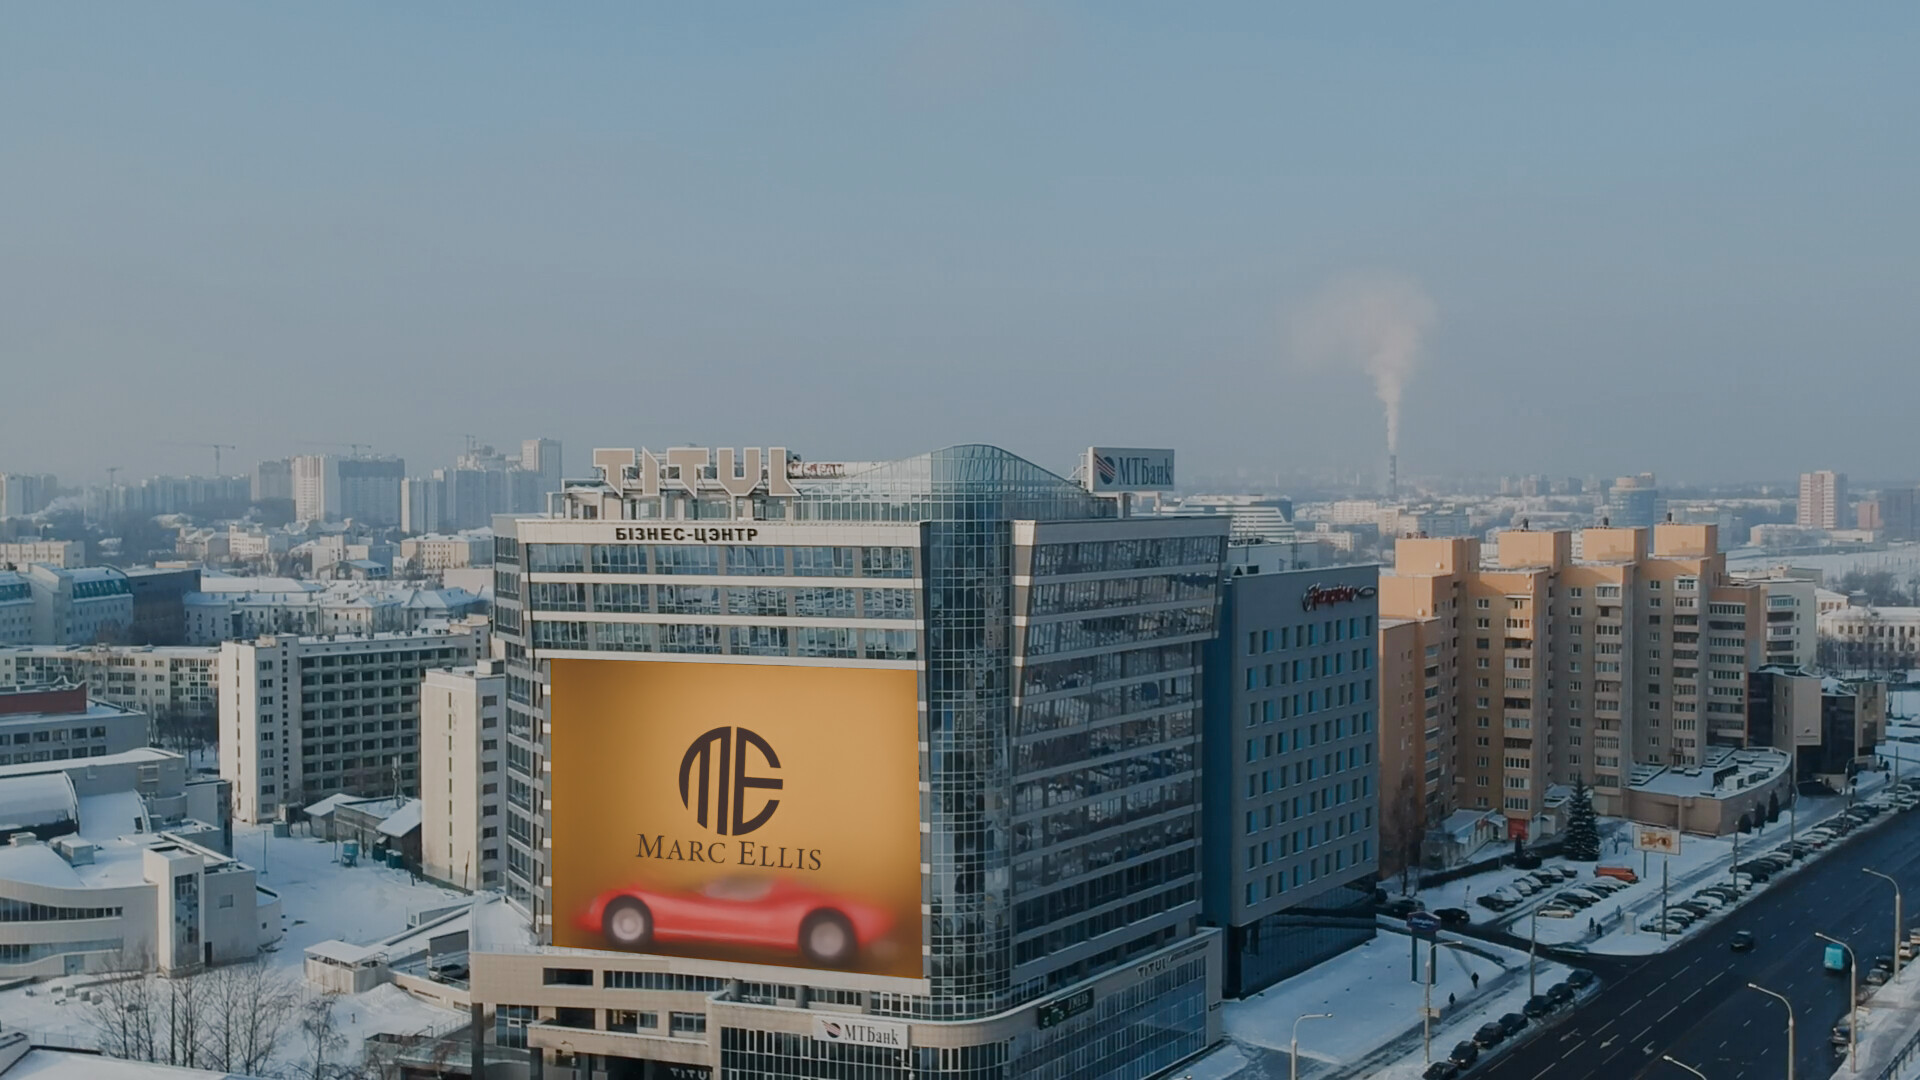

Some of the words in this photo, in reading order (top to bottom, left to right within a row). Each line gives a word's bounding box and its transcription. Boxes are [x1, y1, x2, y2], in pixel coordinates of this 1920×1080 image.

[593, 446, 801, 498] TITUL
[616, 527, 758, 544] БІЗНЕС-ЦЭНТР
[844, 1023, 899, 1046] МТБанк
